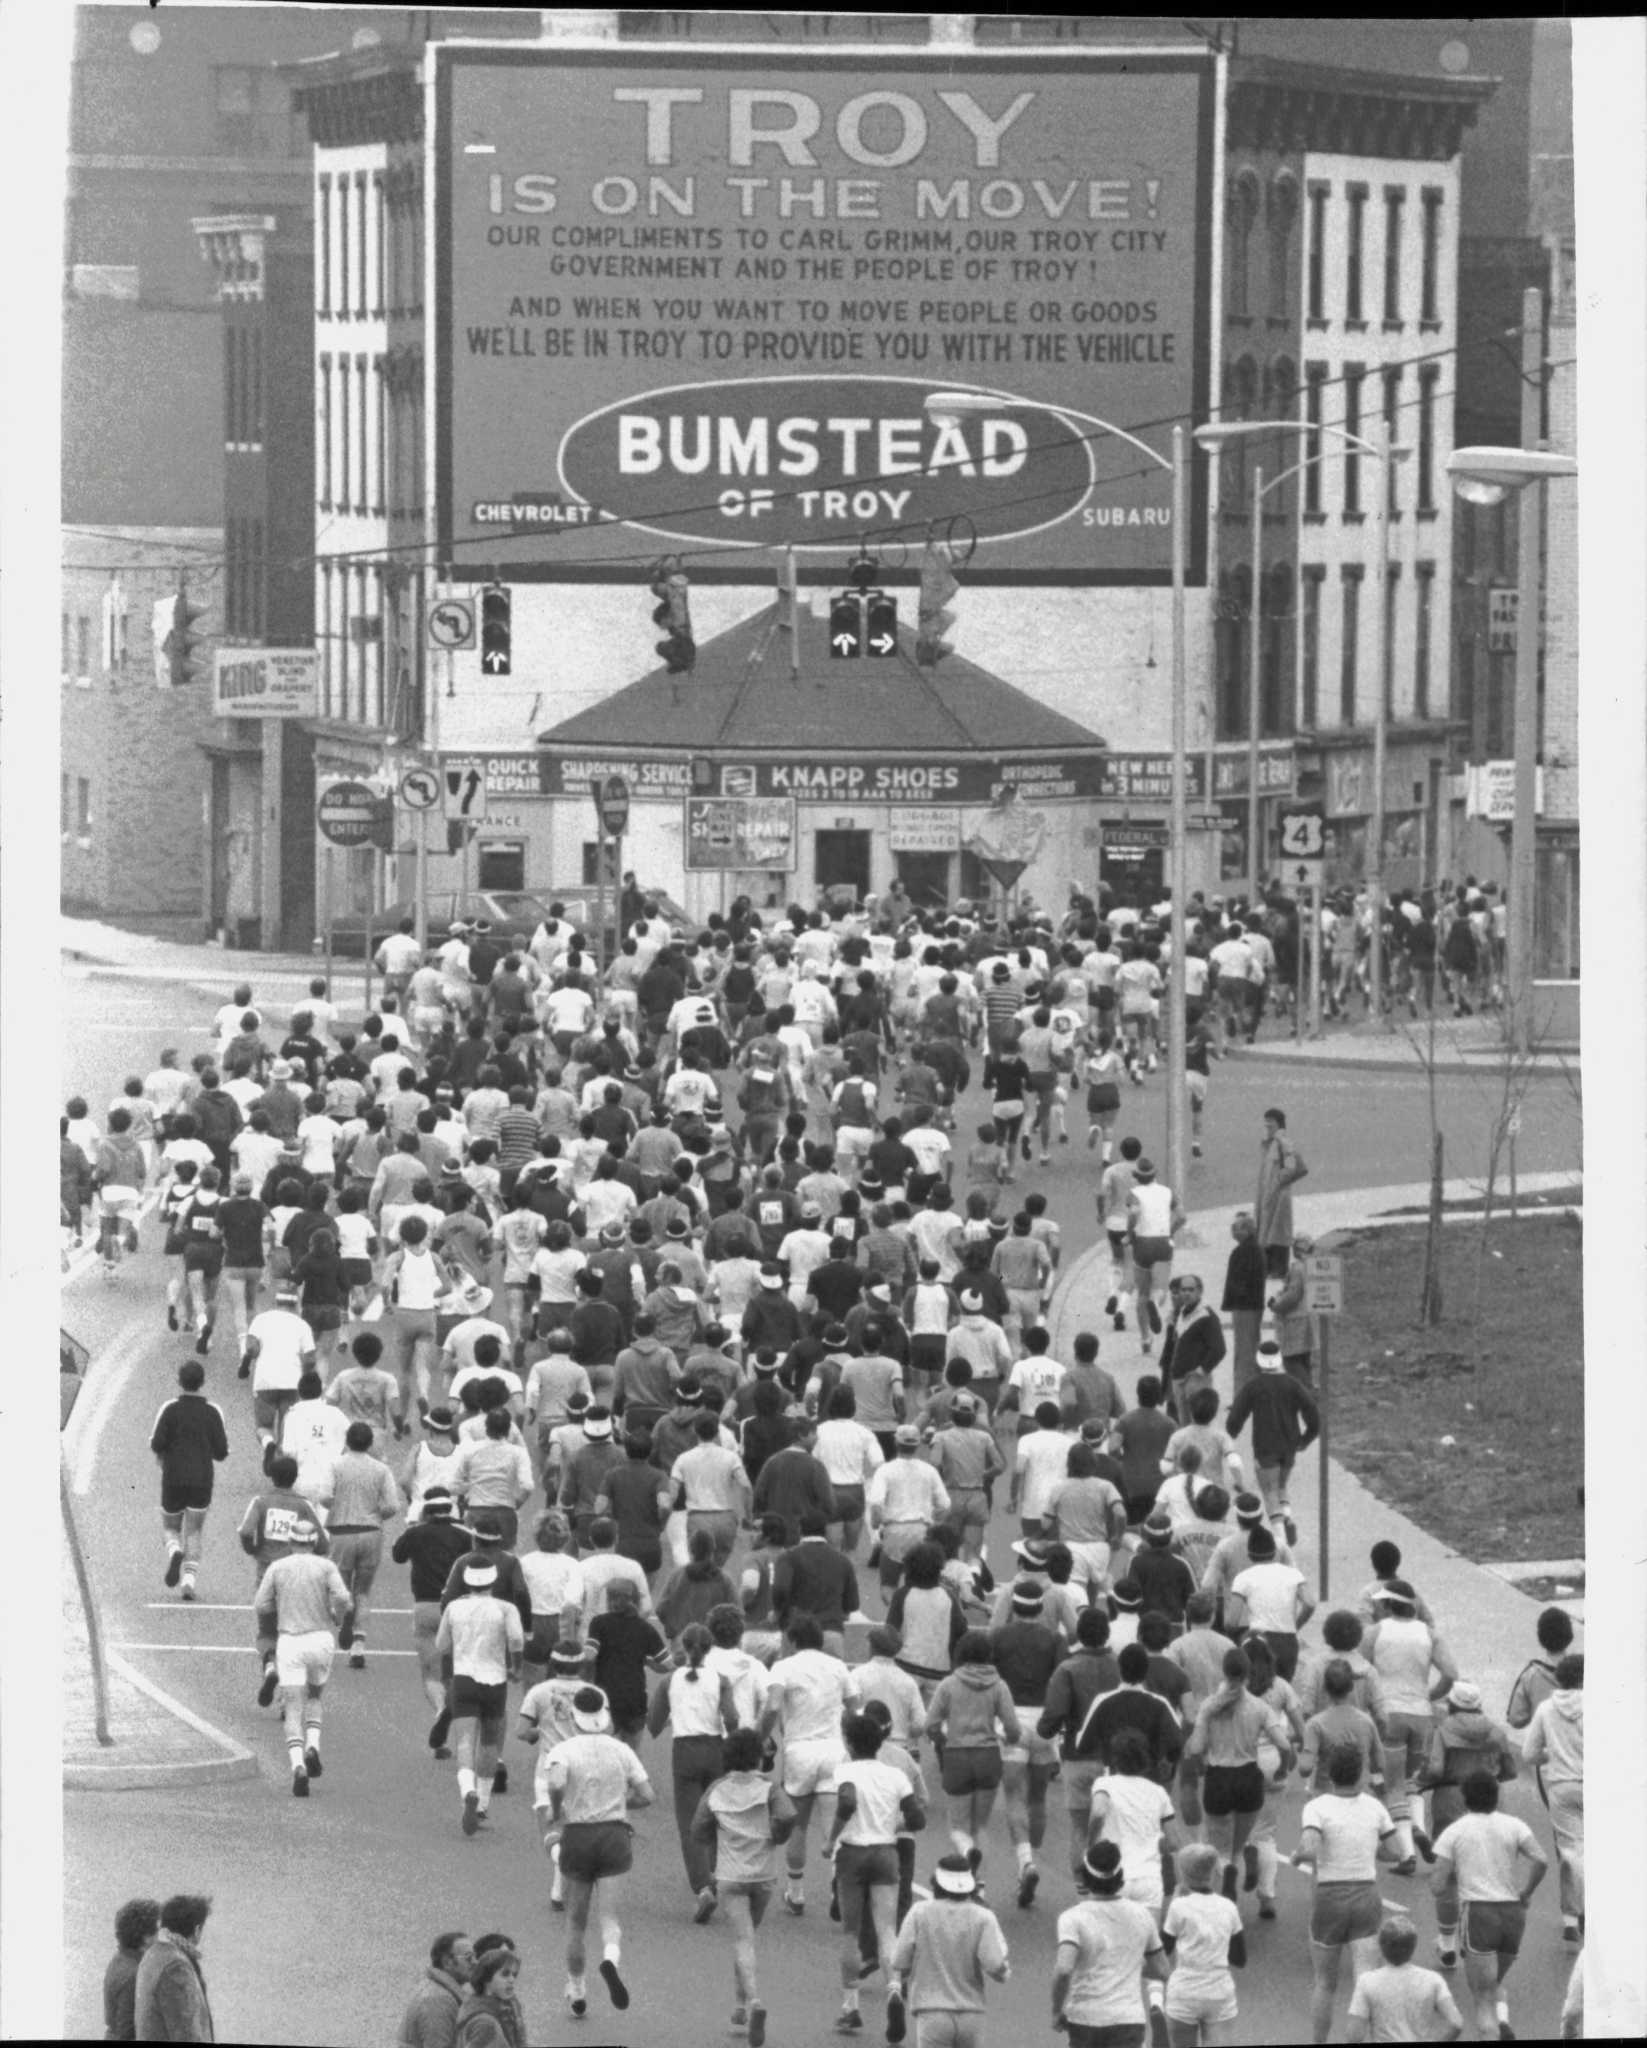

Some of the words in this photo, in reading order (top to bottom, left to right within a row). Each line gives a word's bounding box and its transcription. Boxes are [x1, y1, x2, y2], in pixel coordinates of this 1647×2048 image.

[613, 87, 1036, 168] TROY
[489, 174, 557, 214] IS
[592, 176, 693, 216] ON
[726, 177, 880, 218] THE
[916, 179, 1160, 219] MOVE!
[487, 225, 541, 247] OUR
[552, 226, 722, 249] COMPLIMENTS
[737, 228, 768, 250] TO
[780, 229, 852, 251] CARL
[965, 230, 1017, 251] OUR
[1032, 230, 1098, 251] TROY
[1111, 230, 1167, 251] CITY
[551, 255, 723, 278] GOVERNMENT
[735, 257, 787, 280] AND
[797, 258, 844, 280] THE
[854, 259, 954, 281] PEOPLE
[965, 260, 999, 281] OF
[509, 297, 561, 318] AND
[573, 297, 640, 319] WHEN
[655, 298, 700, 320] YOU
[713, 298, 785, 320] WANT
[798, 300, 829, 321] TO
[840, 301, 908, 322] MOVE
[919, 301, 1017, 323] PEOPLE
[1029, 302, 1062, 323] OR
[1071, 302, 1157, 323] GOODS
[545, 328, 575, 357] BE
[584, 329, 608, 357] IN
[617, 329, 687, 358] TROY
[701, 331, 733, 359] TO
[744, 331, 863, 361] PROVIDE
[875, 332, 928, 360] YOU
[941, 333, 1011, 362] WITH
[1022, 333, 1067, 363] THE
[1077, 333, 1175, 363] VEHICLE
[619, 415, 1028, 477] BUMSTEAD
[474, 504, 592, 522] CHEVROLET
[718, 489, 775, 517] OF
[797, 490, 912, 519] TROY
[1082, 507, 1171, 526] SUBARU
[487, 759, 539, 774] QUICK
[641, 763, 692, 785] SERVICE
[771, 766, 864, 788] KNAPP
[876, 767, 959, 788] SHOES
[1107, 760, 1143, 775] NEW
[1146, 760, 1193, 776] HEES
[486, 776, 541, 791] REPAIR
[1117, 776, 1128, 795] 3
[1132, 778, 1198, 794] MINUES
[326, 793, 343, 805] DO
[1292, 822, 1308, 846] 4
